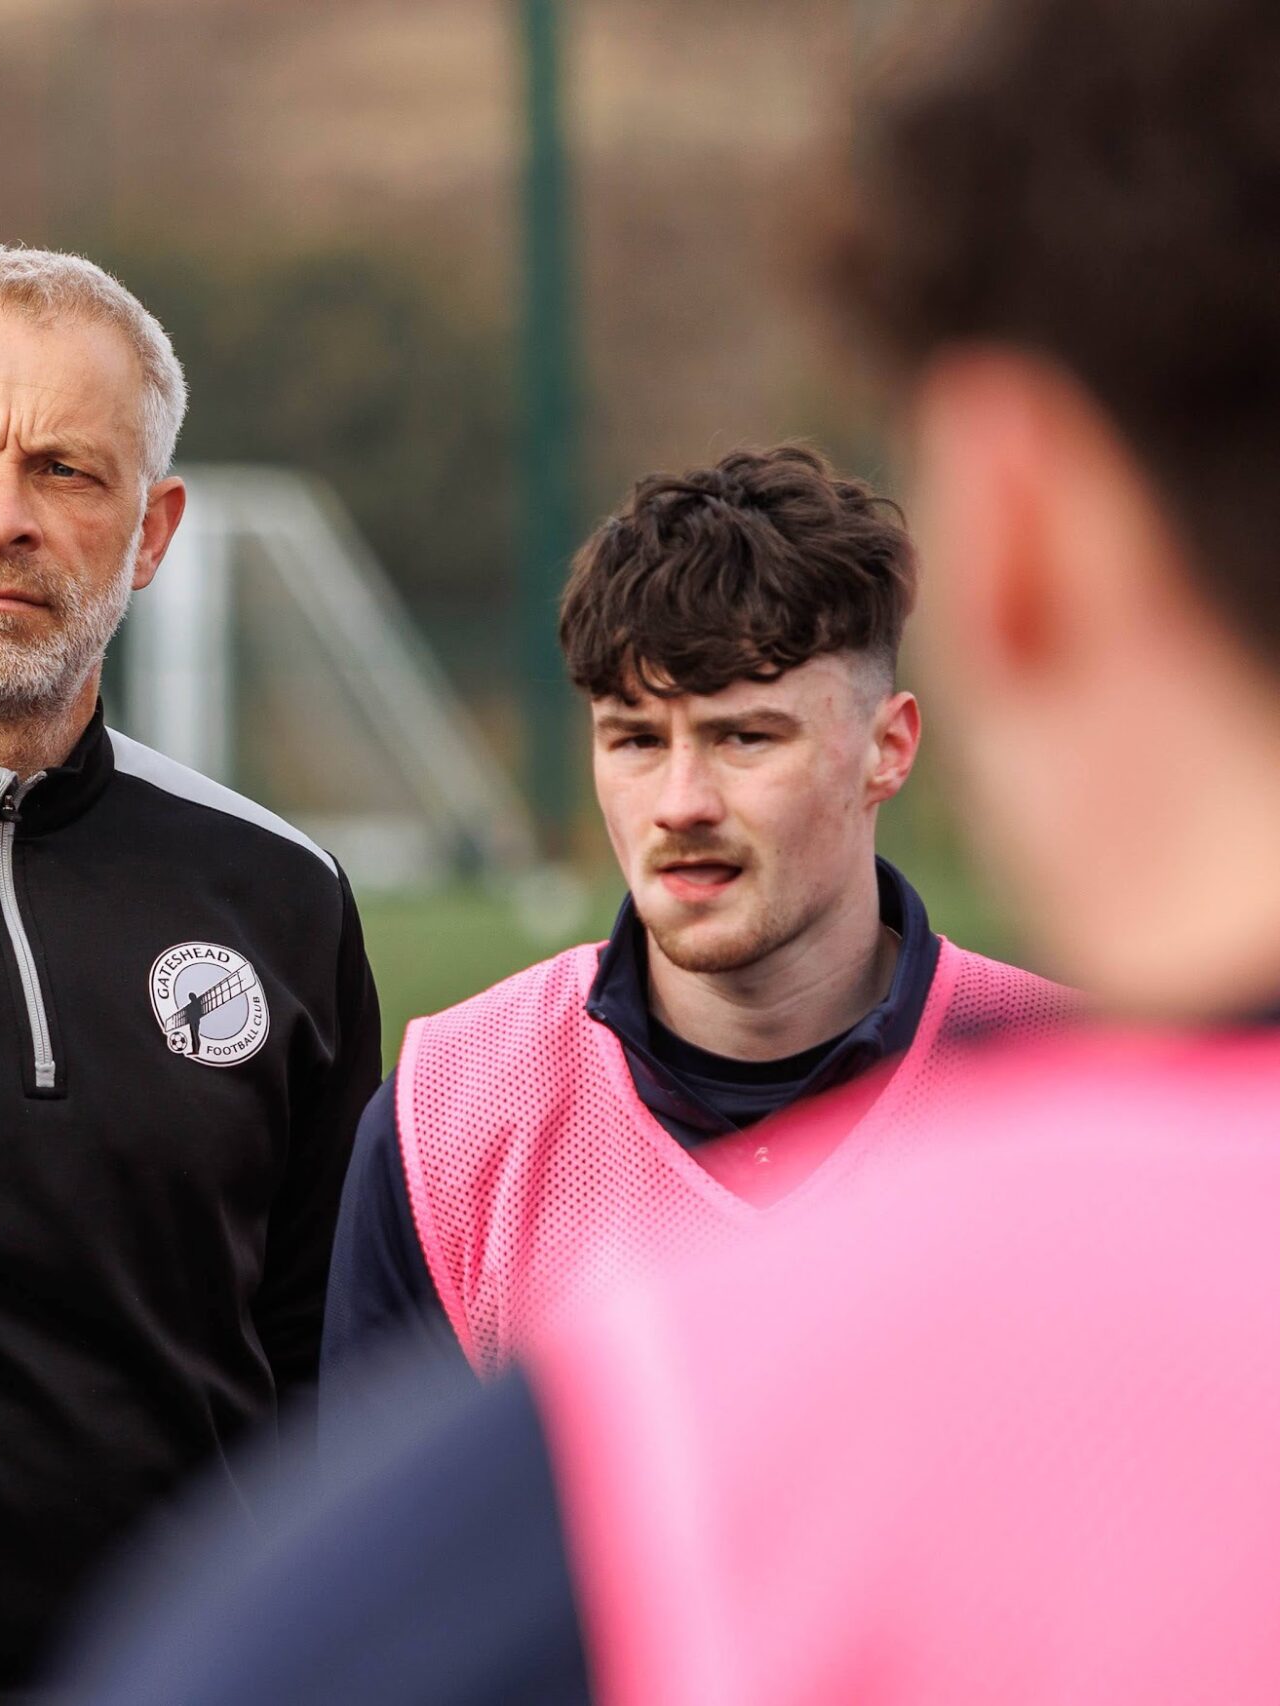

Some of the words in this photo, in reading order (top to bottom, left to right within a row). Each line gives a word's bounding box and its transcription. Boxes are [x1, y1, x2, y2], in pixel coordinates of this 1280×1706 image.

[157, 947, 230, 1000] GATESHEAD
[206, 1029, 259, 1056] FOOTBALL
[253, 996, 262, 1026] CLUB
